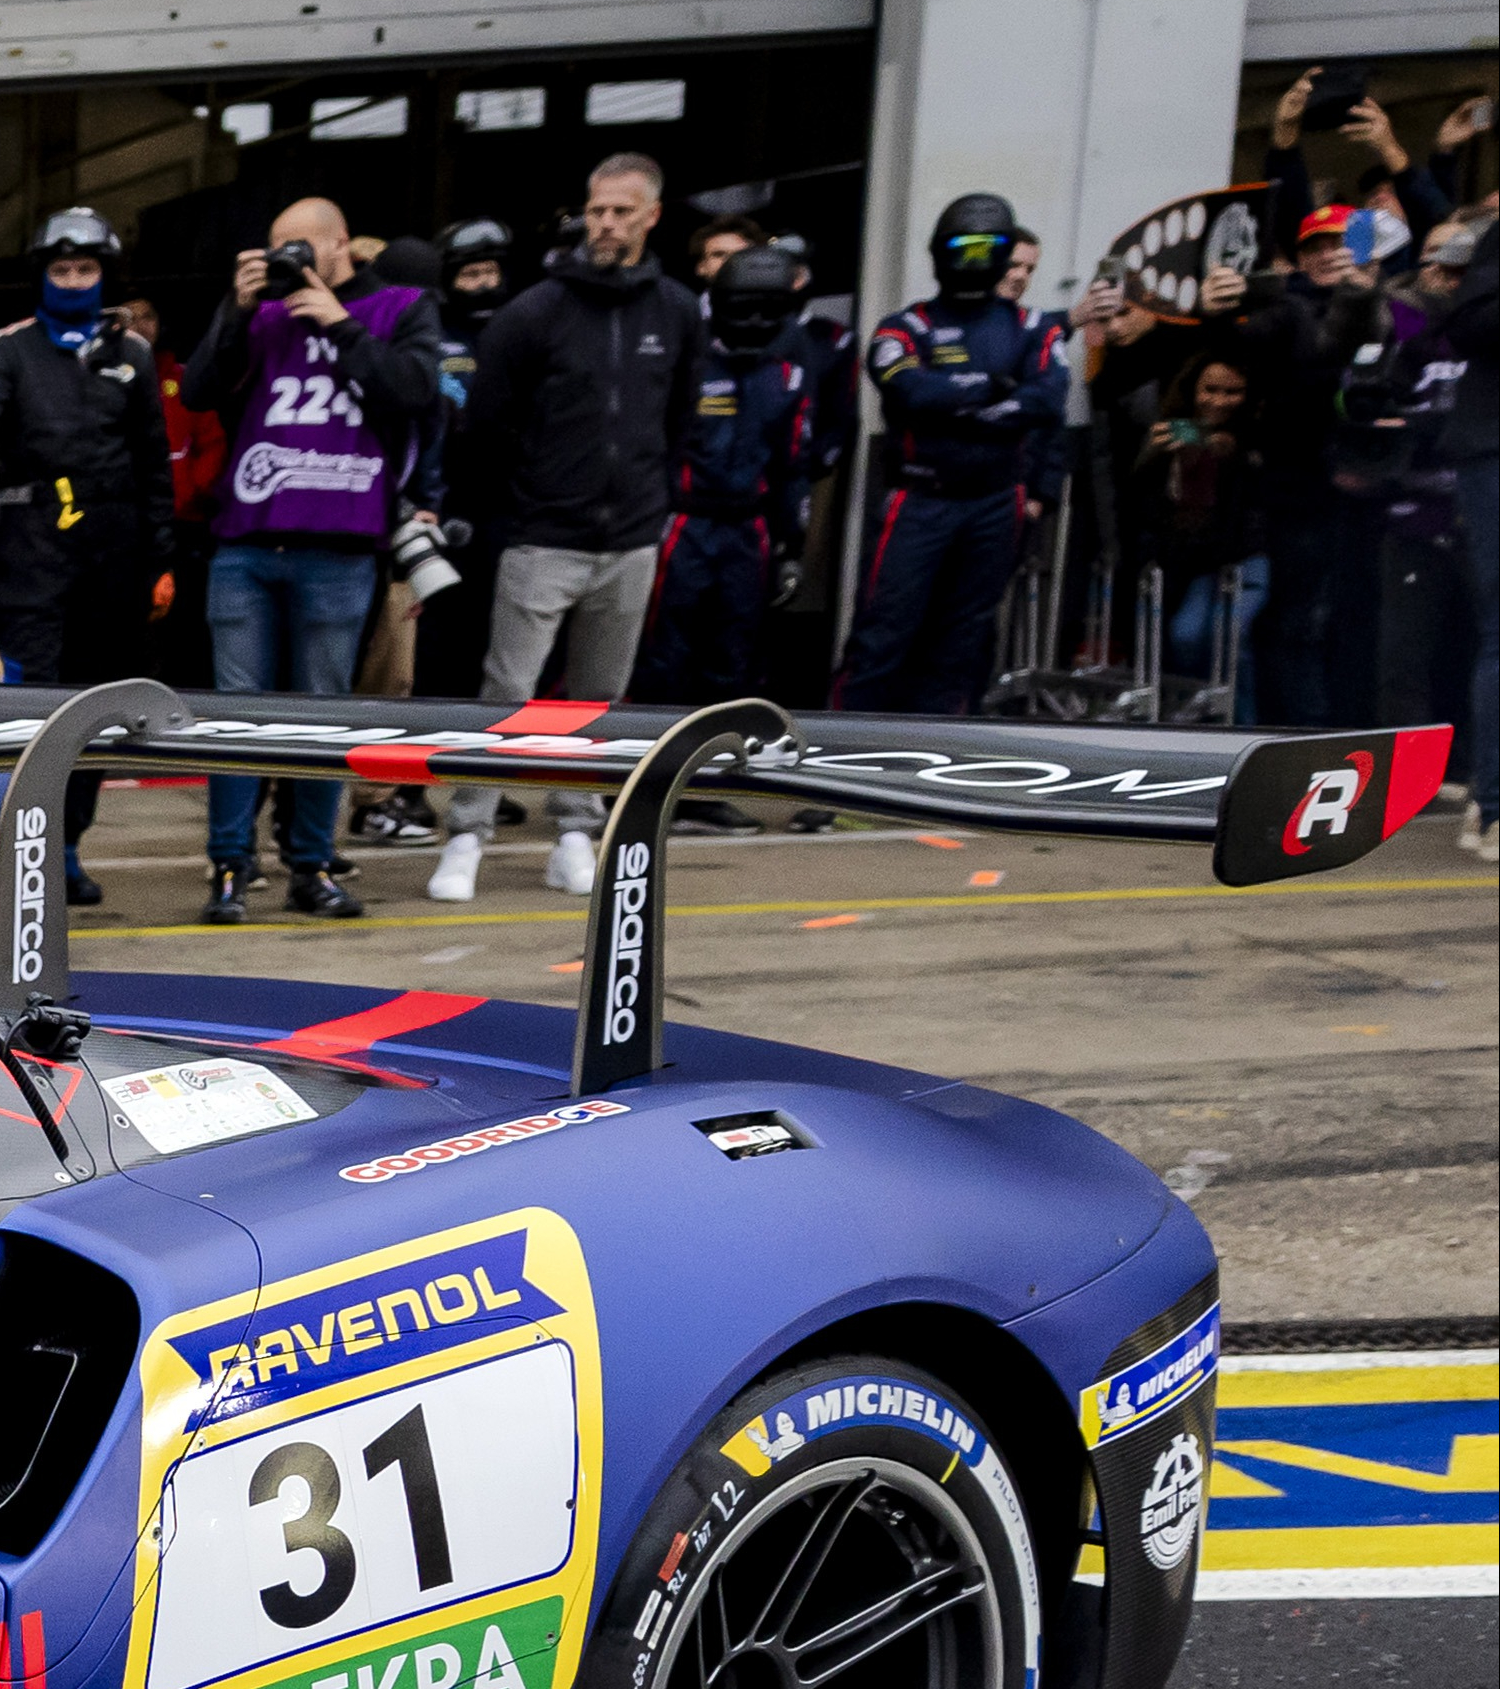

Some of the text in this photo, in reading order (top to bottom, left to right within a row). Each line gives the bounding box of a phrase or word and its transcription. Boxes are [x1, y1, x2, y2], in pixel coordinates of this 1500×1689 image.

[12, 806, 48, 984] sparco
[601, 842, 650, 1046] sparco
[345, 1100, 623, 1181] GOODRIDGE
[209, 1272, 523, 1394] RAVENOL
[1135, 1330, 1217, 1406] MICHELIN
[804, 1375, 981, 1457] MICHELIN
[247, 1402, 456, 1629] 31
